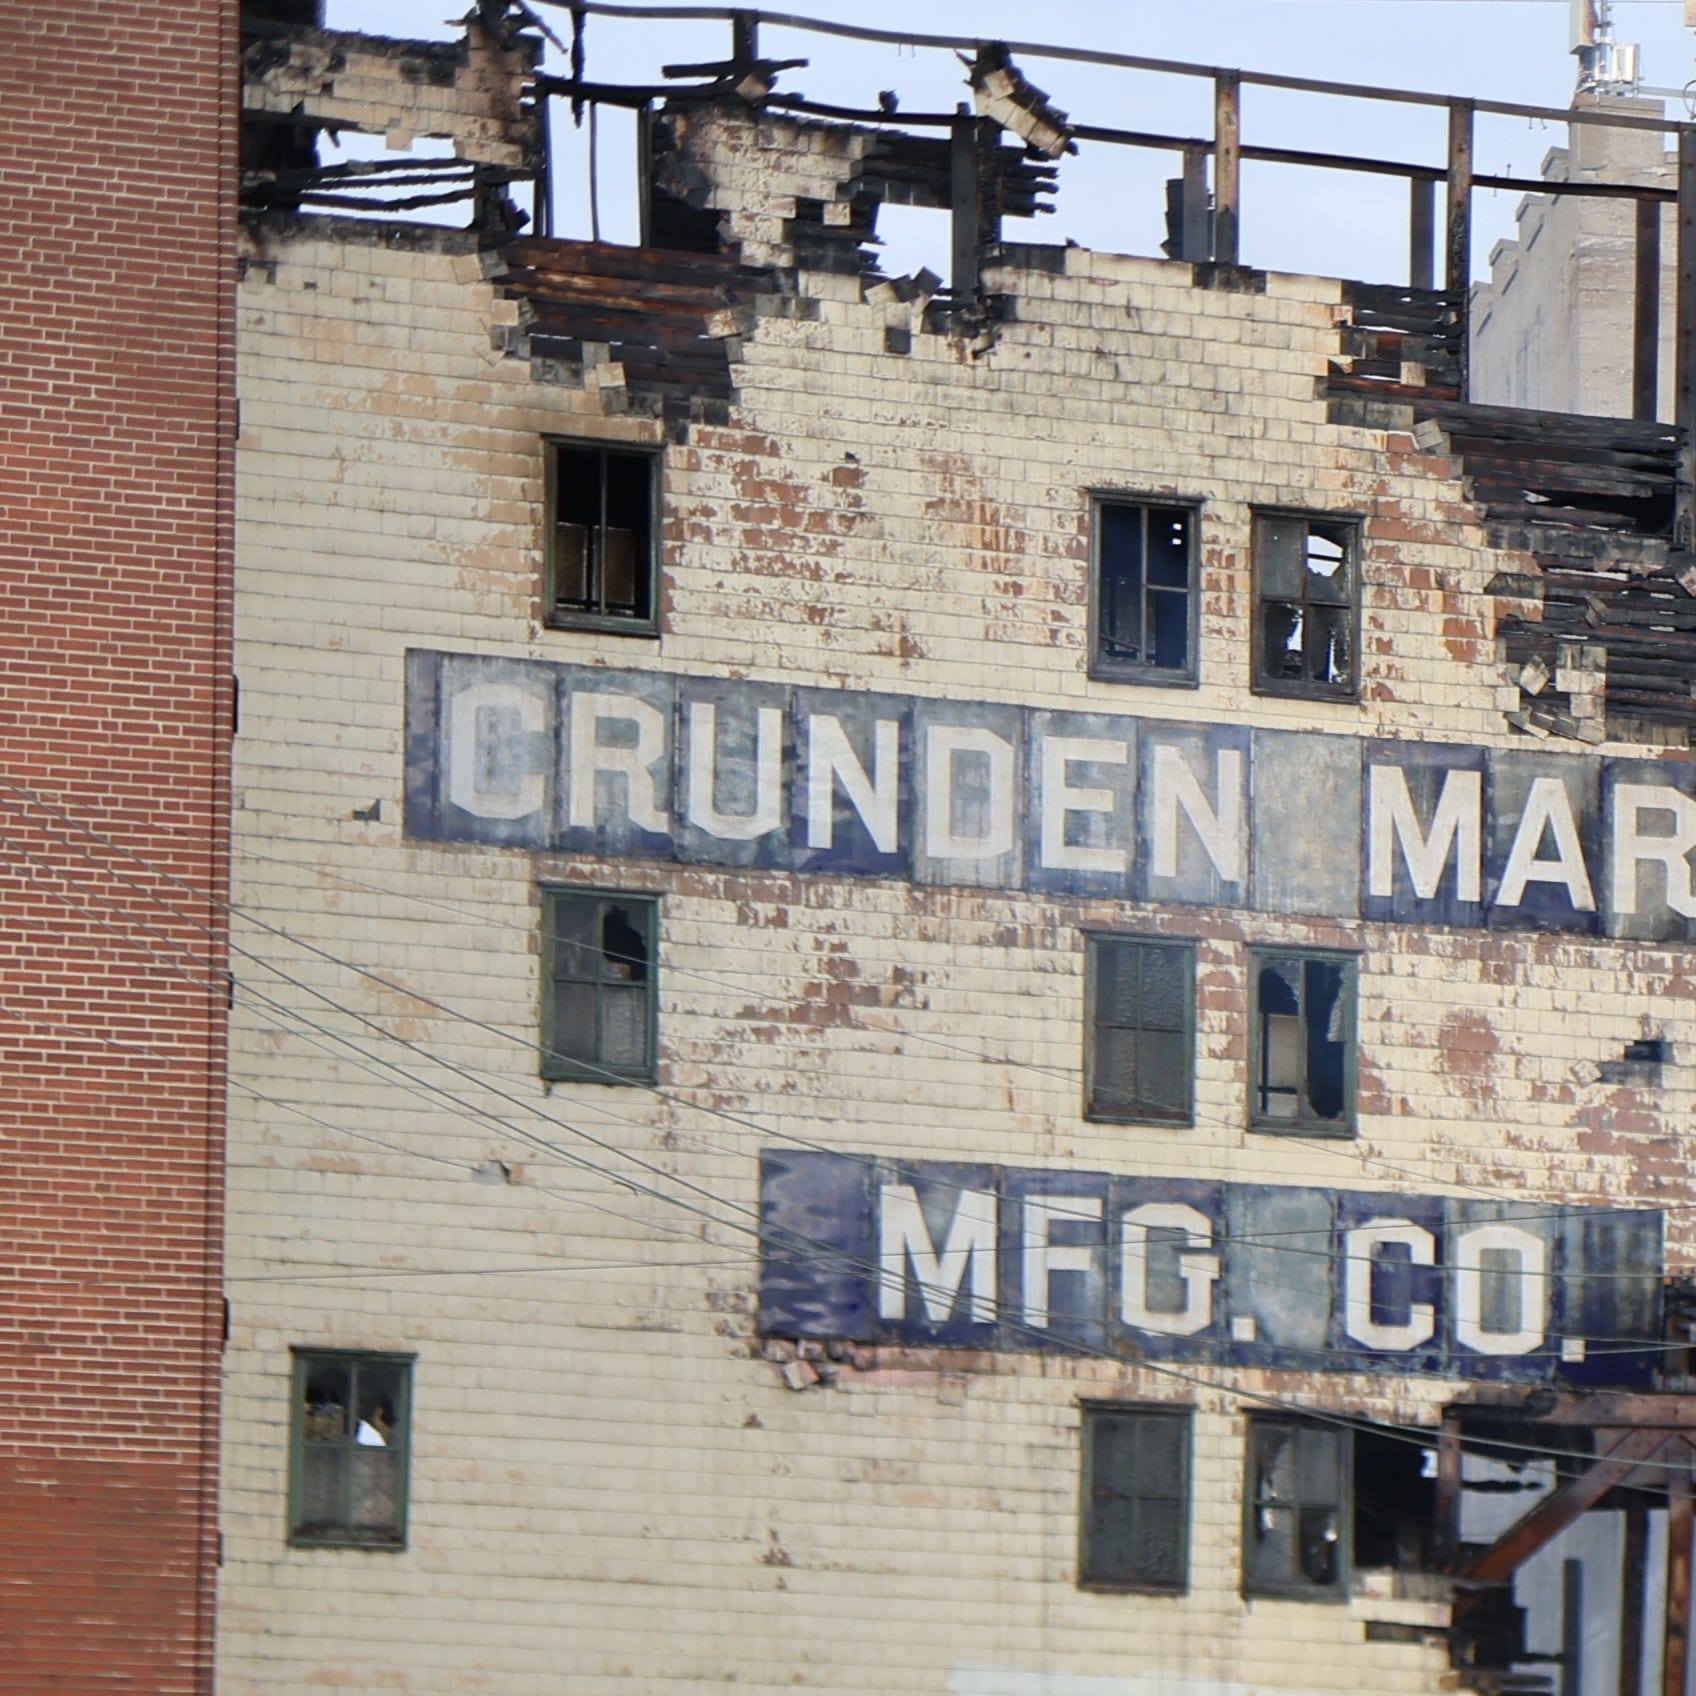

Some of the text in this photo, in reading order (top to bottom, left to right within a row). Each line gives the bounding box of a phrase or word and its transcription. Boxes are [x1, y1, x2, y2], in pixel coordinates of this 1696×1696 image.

[448, 682, 1241, 882] CRUNDEN
[878, 1184, 1587, 1363] MFG. CO.
